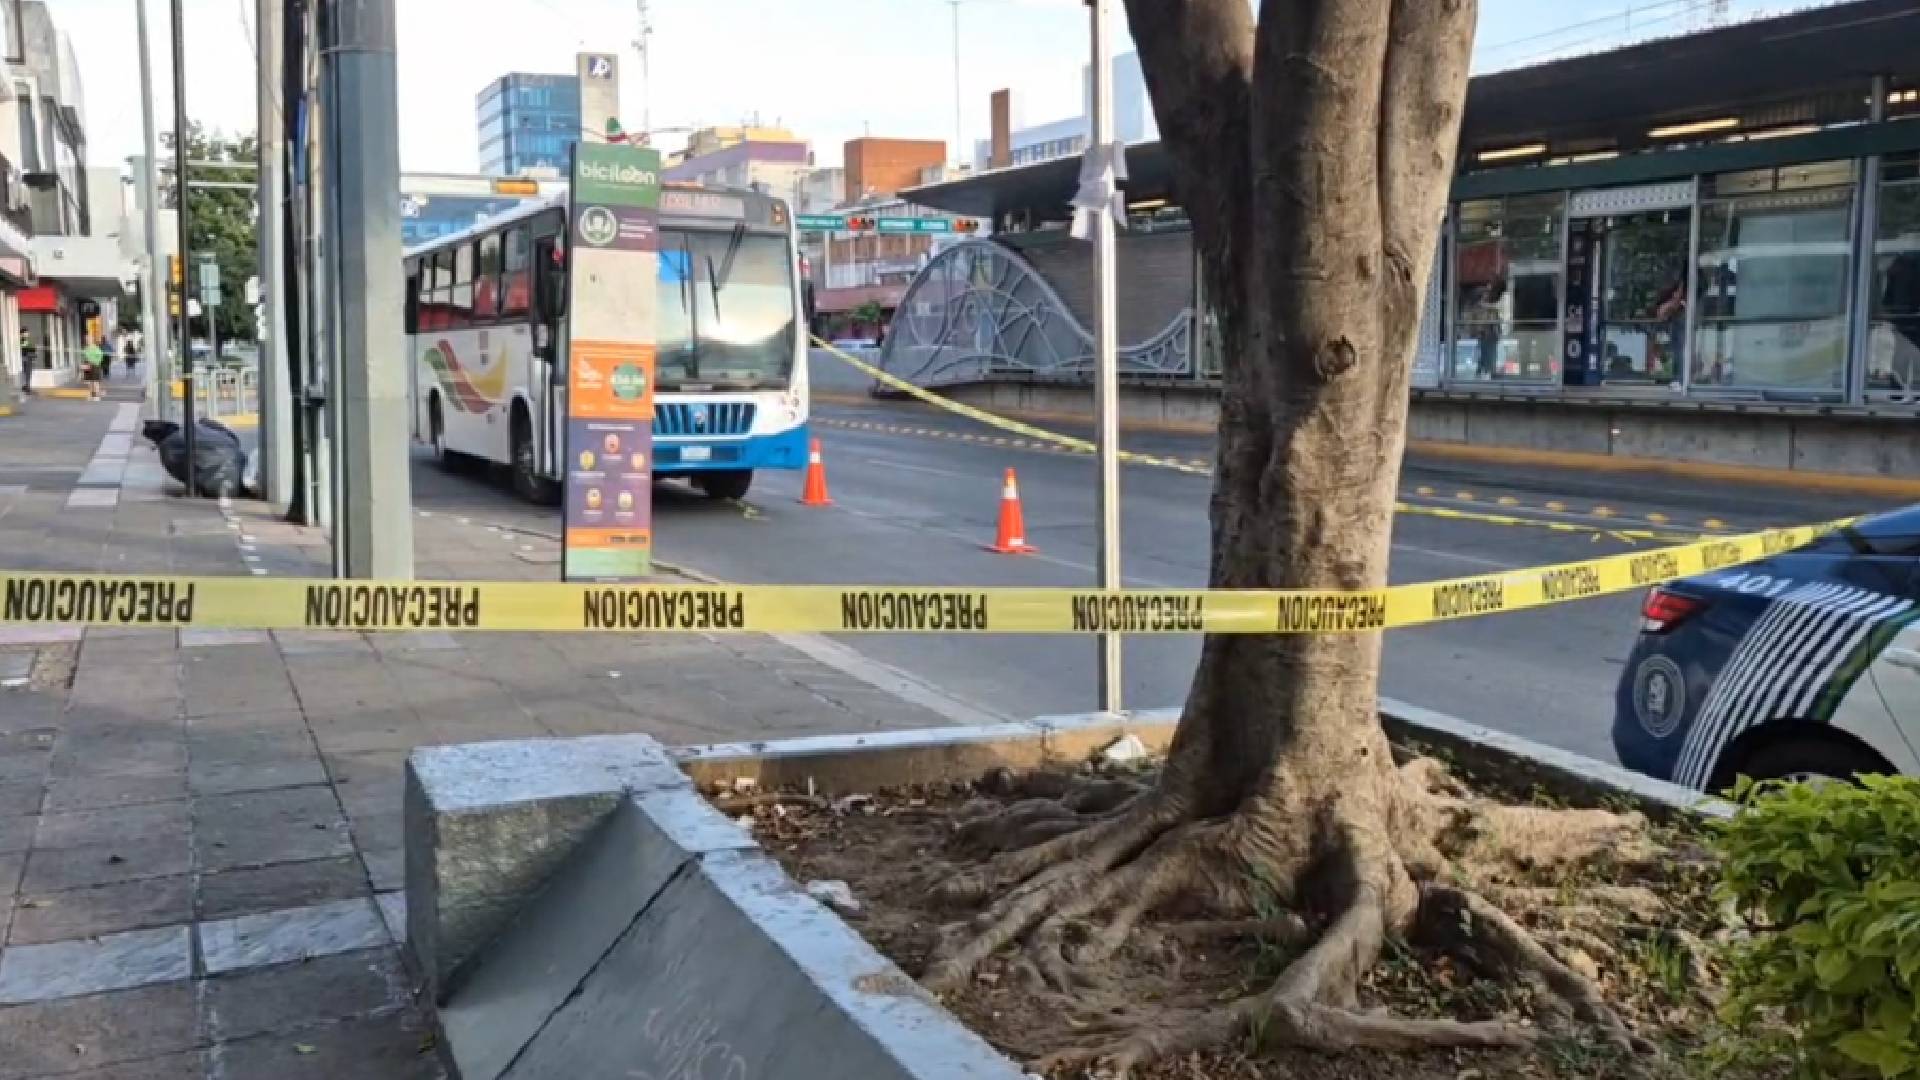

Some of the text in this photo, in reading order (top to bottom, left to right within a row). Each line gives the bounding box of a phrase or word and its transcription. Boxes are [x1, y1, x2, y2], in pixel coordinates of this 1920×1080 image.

[4, 579, 194, 623] PRECAUCION
[305, 585, 480, 625] PRECAUCION
[583, 590, 744, 629] PRECAUCION
[841, 592, 987, 630] PRECAUCION
[1072, 594, 1203, 631] PRECAUCION
